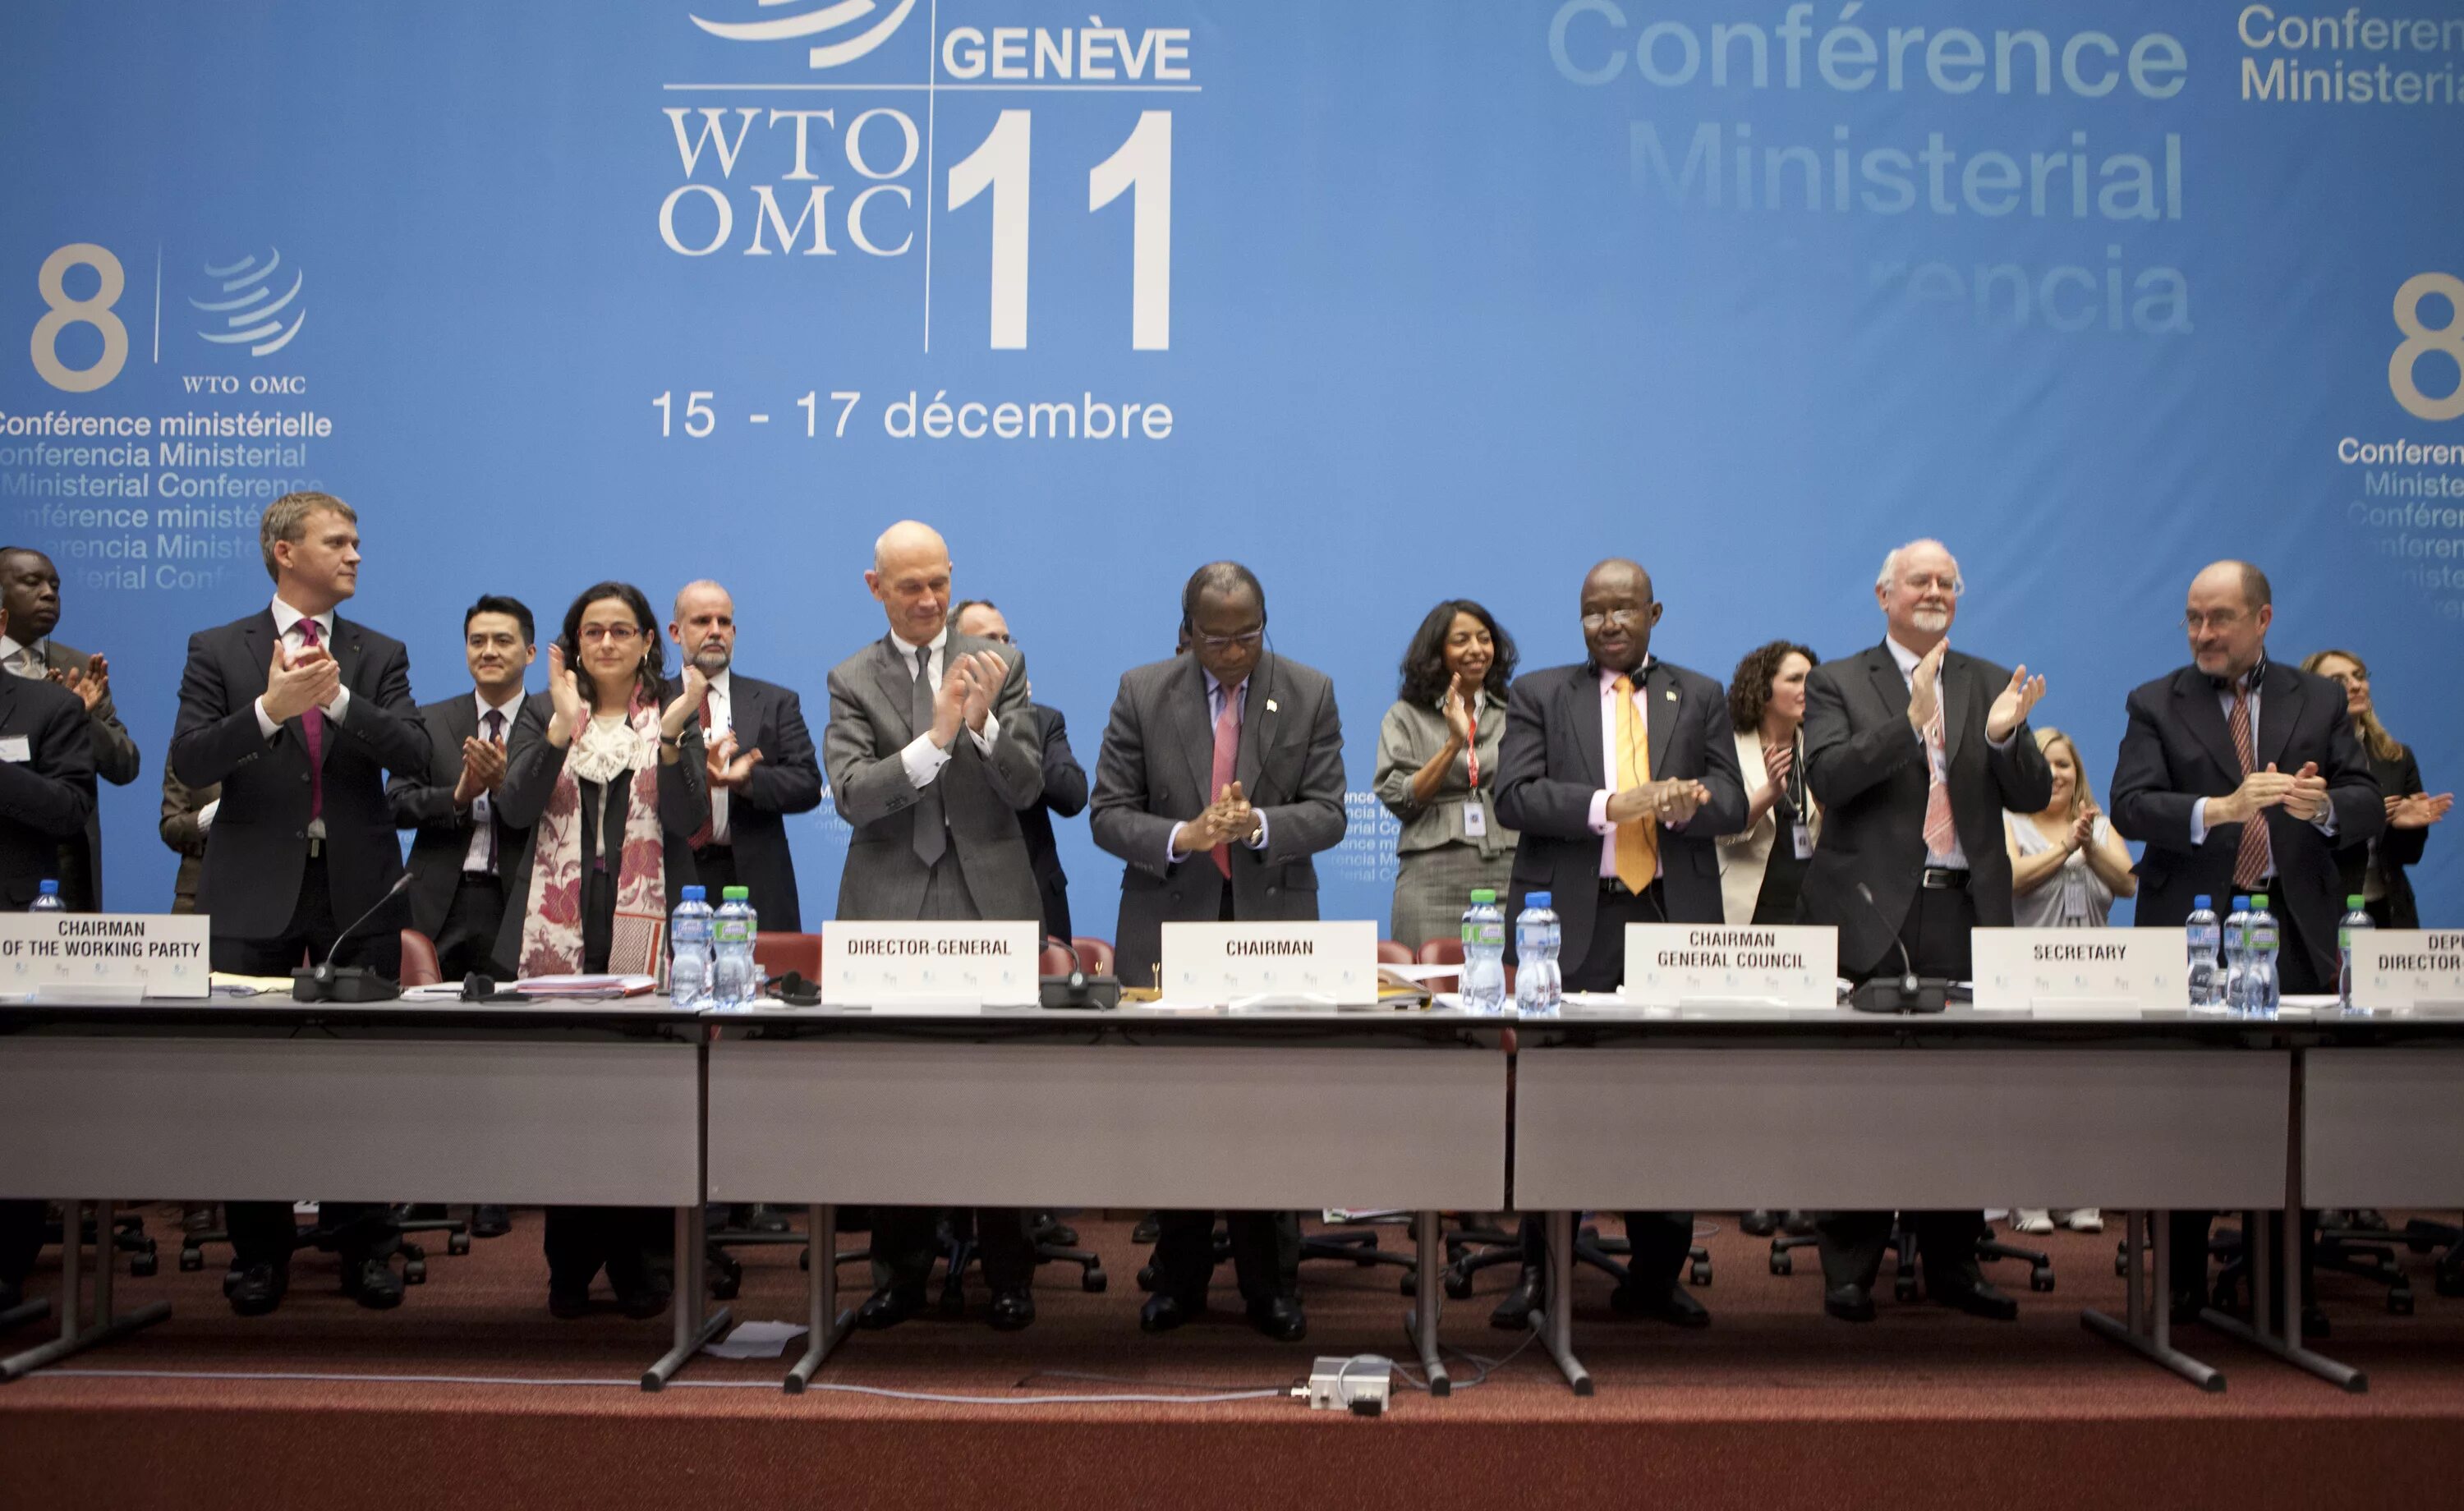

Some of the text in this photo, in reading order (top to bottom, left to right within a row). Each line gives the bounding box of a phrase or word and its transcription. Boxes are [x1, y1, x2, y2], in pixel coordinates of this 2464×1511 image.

[942, 15, 1190, 80] GENÈVE
[1548, 0, 2188, 99] Conférence
[2241, 57, 2464, 104] Ministeri
[662, 108, 920, 180] WTO
[1630, 122, 2183, 221] Ministerial
[659, 184, 913, 256] OMC
[948, 110, 1172, 351] 11
[30, 242, 129, 393] 8
[2388, 272, 2464, 422] 8
[182, 376, 306, 394] WTO OMC
[160, 411, 333, 437] ministérielle
[653, 390, 715, 438] 15
[797, 390, 861, 438] 17
[884, 390, 1174, 439] décembre
[159, 441, 306, 467] Ministerial
[2, 472, 149, 497] Ministerial
[2347, 499, 2464, 528] Confére
[58, 920, 145, 936] CHAIRMAN
[1689, 930, 1776, 948] CHAIRMAN
[2, 940, 200, 958] OF THE WORKING PARTY
[848, 939, 1012, 956] DIRECTOR-GENERAL
[1226, 939, 1314, 956] CHAIRMAN
[2034, 944, 2127, 961] SECRETARY
[2429, 934, 2464, 951] DEP
[1657, 951, 1806, 969] GENERAL COUNCIL
